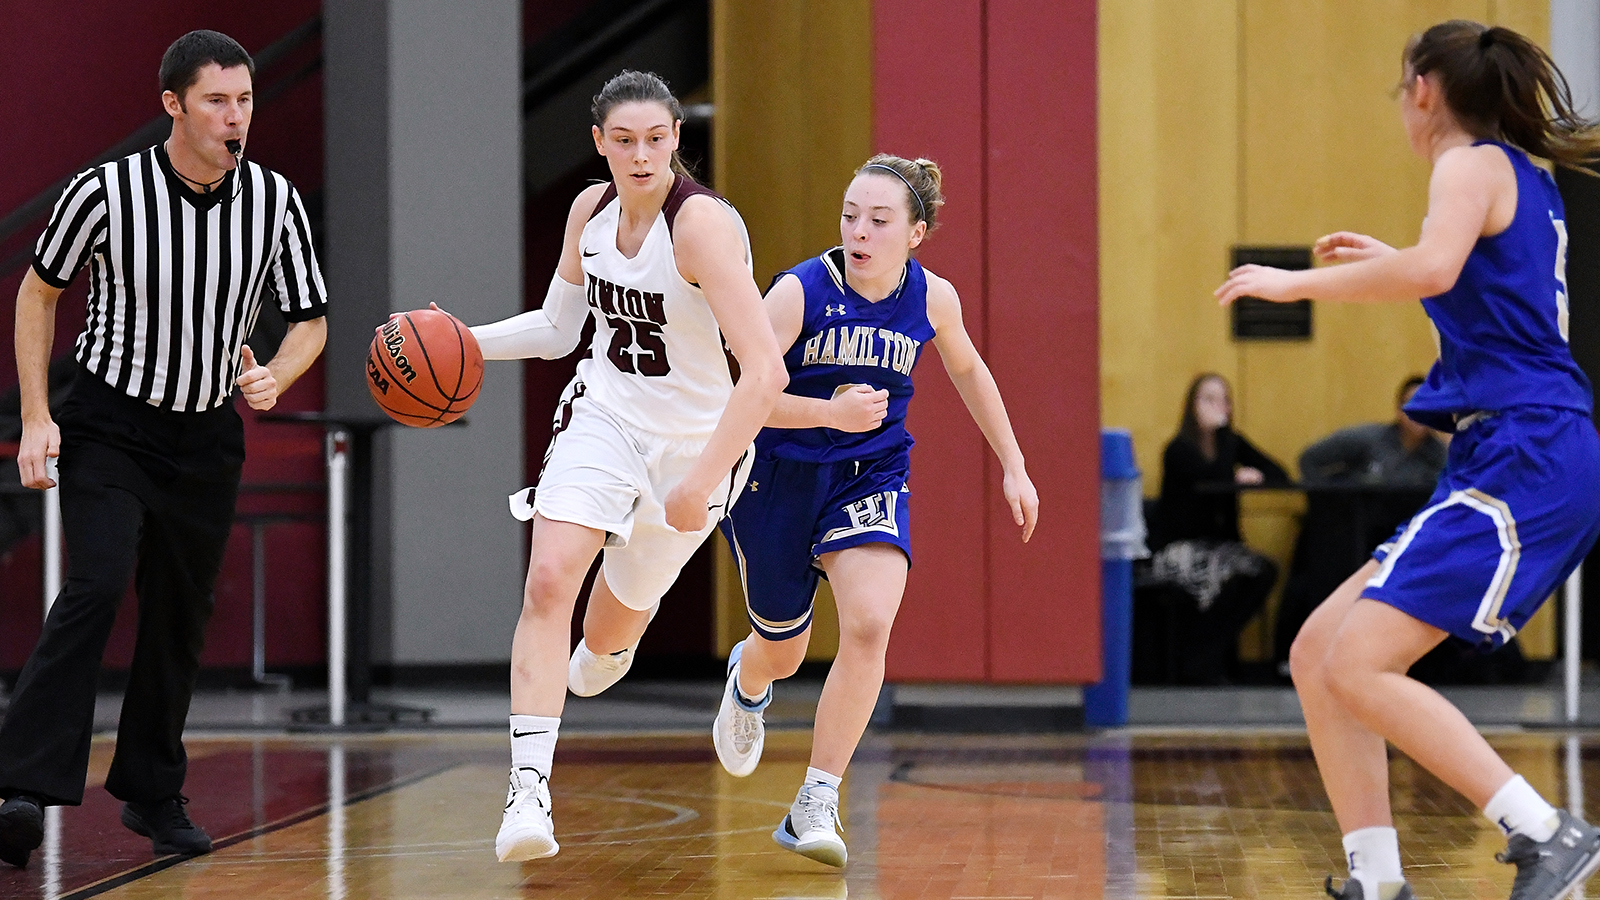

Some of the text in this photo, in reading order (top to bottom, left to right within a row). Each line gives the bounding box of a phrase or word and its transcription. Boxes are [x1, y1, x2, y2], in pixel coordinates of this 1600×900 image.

[586, 271, 668, 326] UNION
[366, 350, 391, 396] CAA
[382, 318, 418, 384] Wilson
[605, 315, 672, 377] 25
[802, 325, 921, 377] HAMILTON
